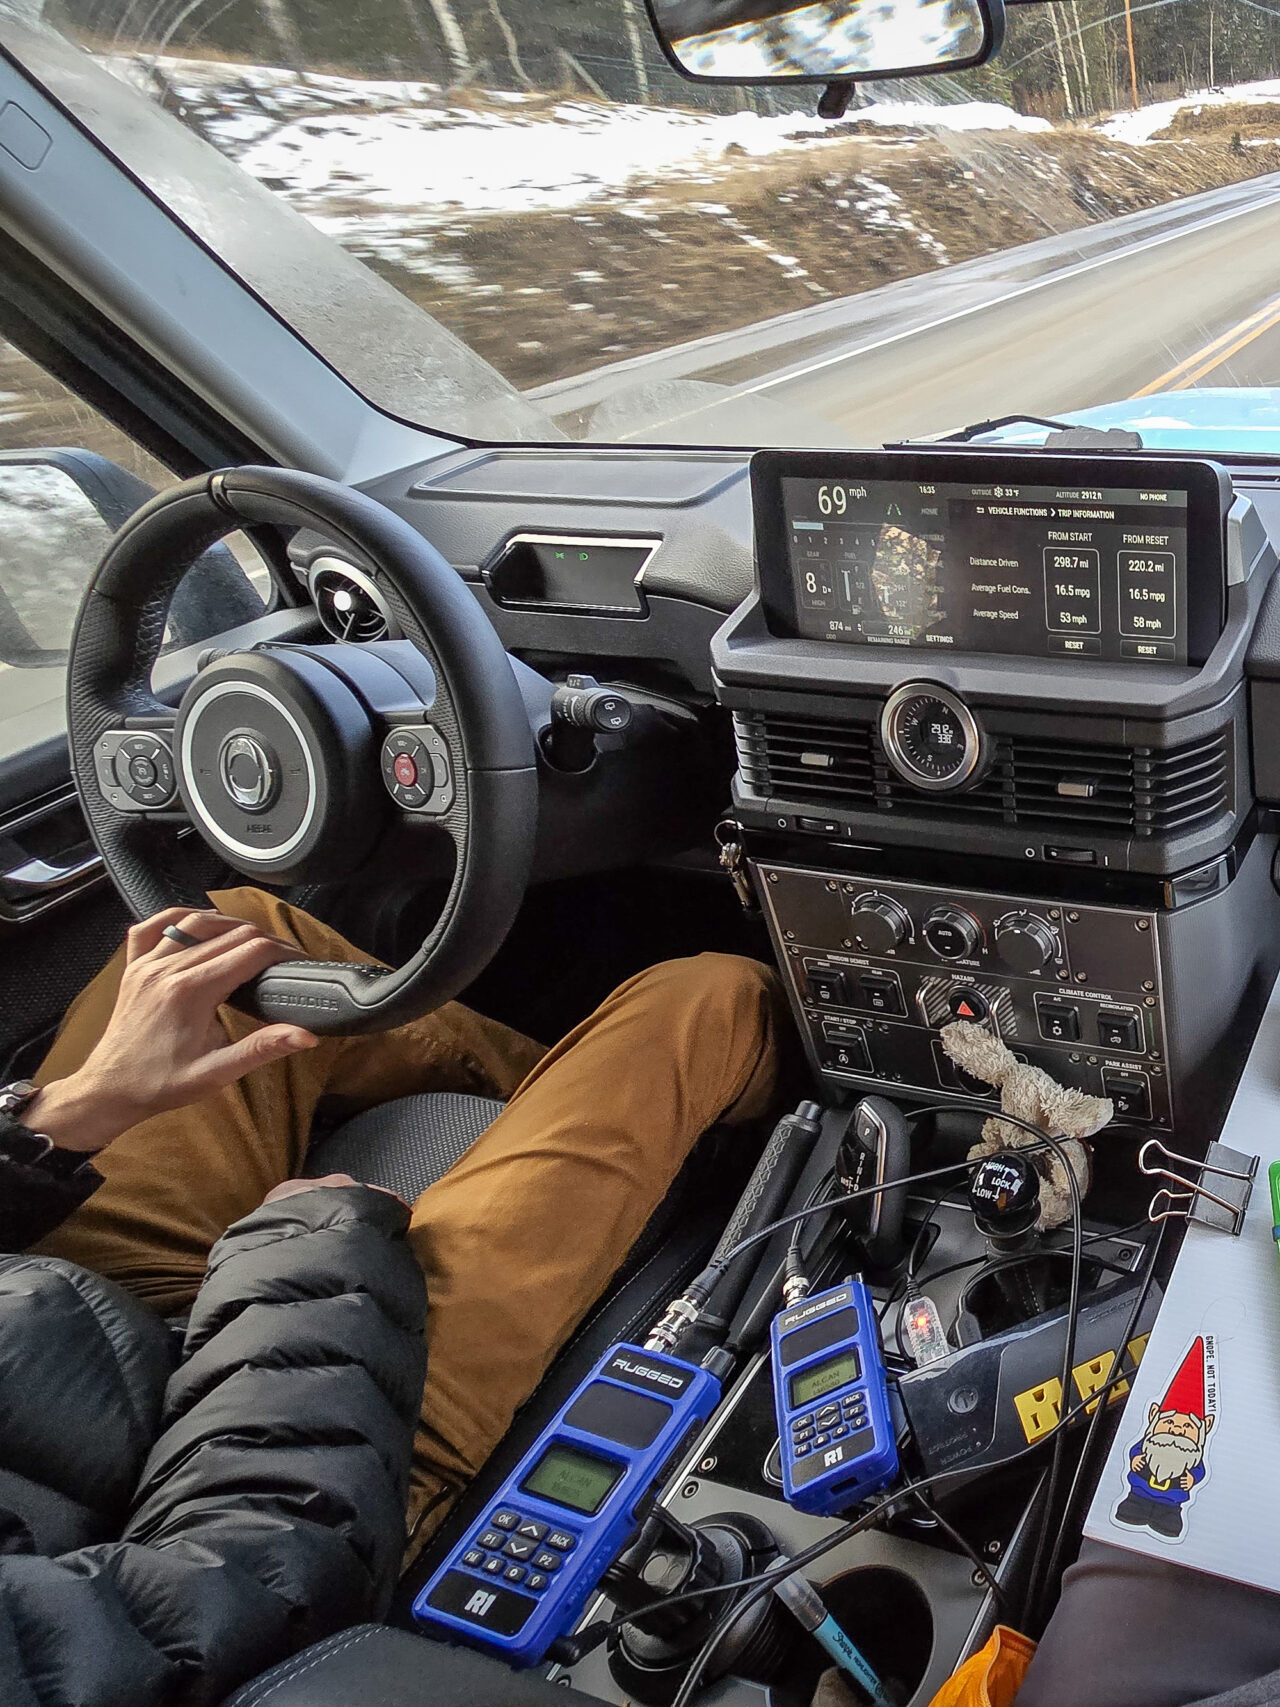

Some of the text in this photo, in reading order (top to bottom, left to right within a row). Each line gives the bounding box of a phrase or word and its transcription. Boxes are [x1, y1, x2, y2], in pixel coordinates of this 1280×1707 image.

[818, 486, 867, 514] 69 mph
[988, 506, 1114, 519] VEHICLE FUNCTIONS TRIP INFORMATION
[1048, 531, 1092, 542] FROM START
[1123, 534, 1169, 546] FROM RESET
[969, 557, 1019, 568] Distance Driven
[1054, 556, 1089, 569] 298.7 mi
[1128, 560, 1164, 573] 220.2 mi
[805, 572, 816, 593] 8
[971, 583, 996, 594] Average
[997, 584, 1011, 594] Fuel
[1055, 584, 1090, 599] 16.5 mpg
[1129, 588, 1165, 603] 16.5 mpg
[973, 609, 1019, 621] Average Speed
[1060, 612, 1087, 625] 53 mph
[1133, 616, 1162, 630] 58 mph
[888, 625, 903, 635] 246
[926, 635, 953, 643] SETTINGS
[1065, 641, 1084, 650] RESET
[1138, 646, 1157, 655] RESET
[938, 929, 952, 937] AUTO
[951, 974, 975, 982] HAZARD
[1059, 988, 1113, 1000] CLIMATE CONTROL
[1105, 1060, 1142, 1070] PARK ASSIST
[991, 1177, 1011, 1189] LOCK
[977, 1188, 992, 1199] LOW
[784, 1292, 847, 1326] RUGGED
[612, 1359, 684, 1388] RUGGED
[1205, 1335, 1217, 1412] GNOPE. NOT TODAY!
[845, 1393, 860, 1403] BACK
[797, 1418, 808, 1427] OK
[800, 1431, 809, 1439] P1
[824, 1446, 843, 1468] R1
[498, 1514, 512, 1525] OK
[483, 1534, 496, 1544] P1
[550, 1534, 571, 1547] BACK
[465, 1551, 479, 1561] FM
[538, 1555, 552, 1566] P2
[464, 1589, 497, 1617] R1
